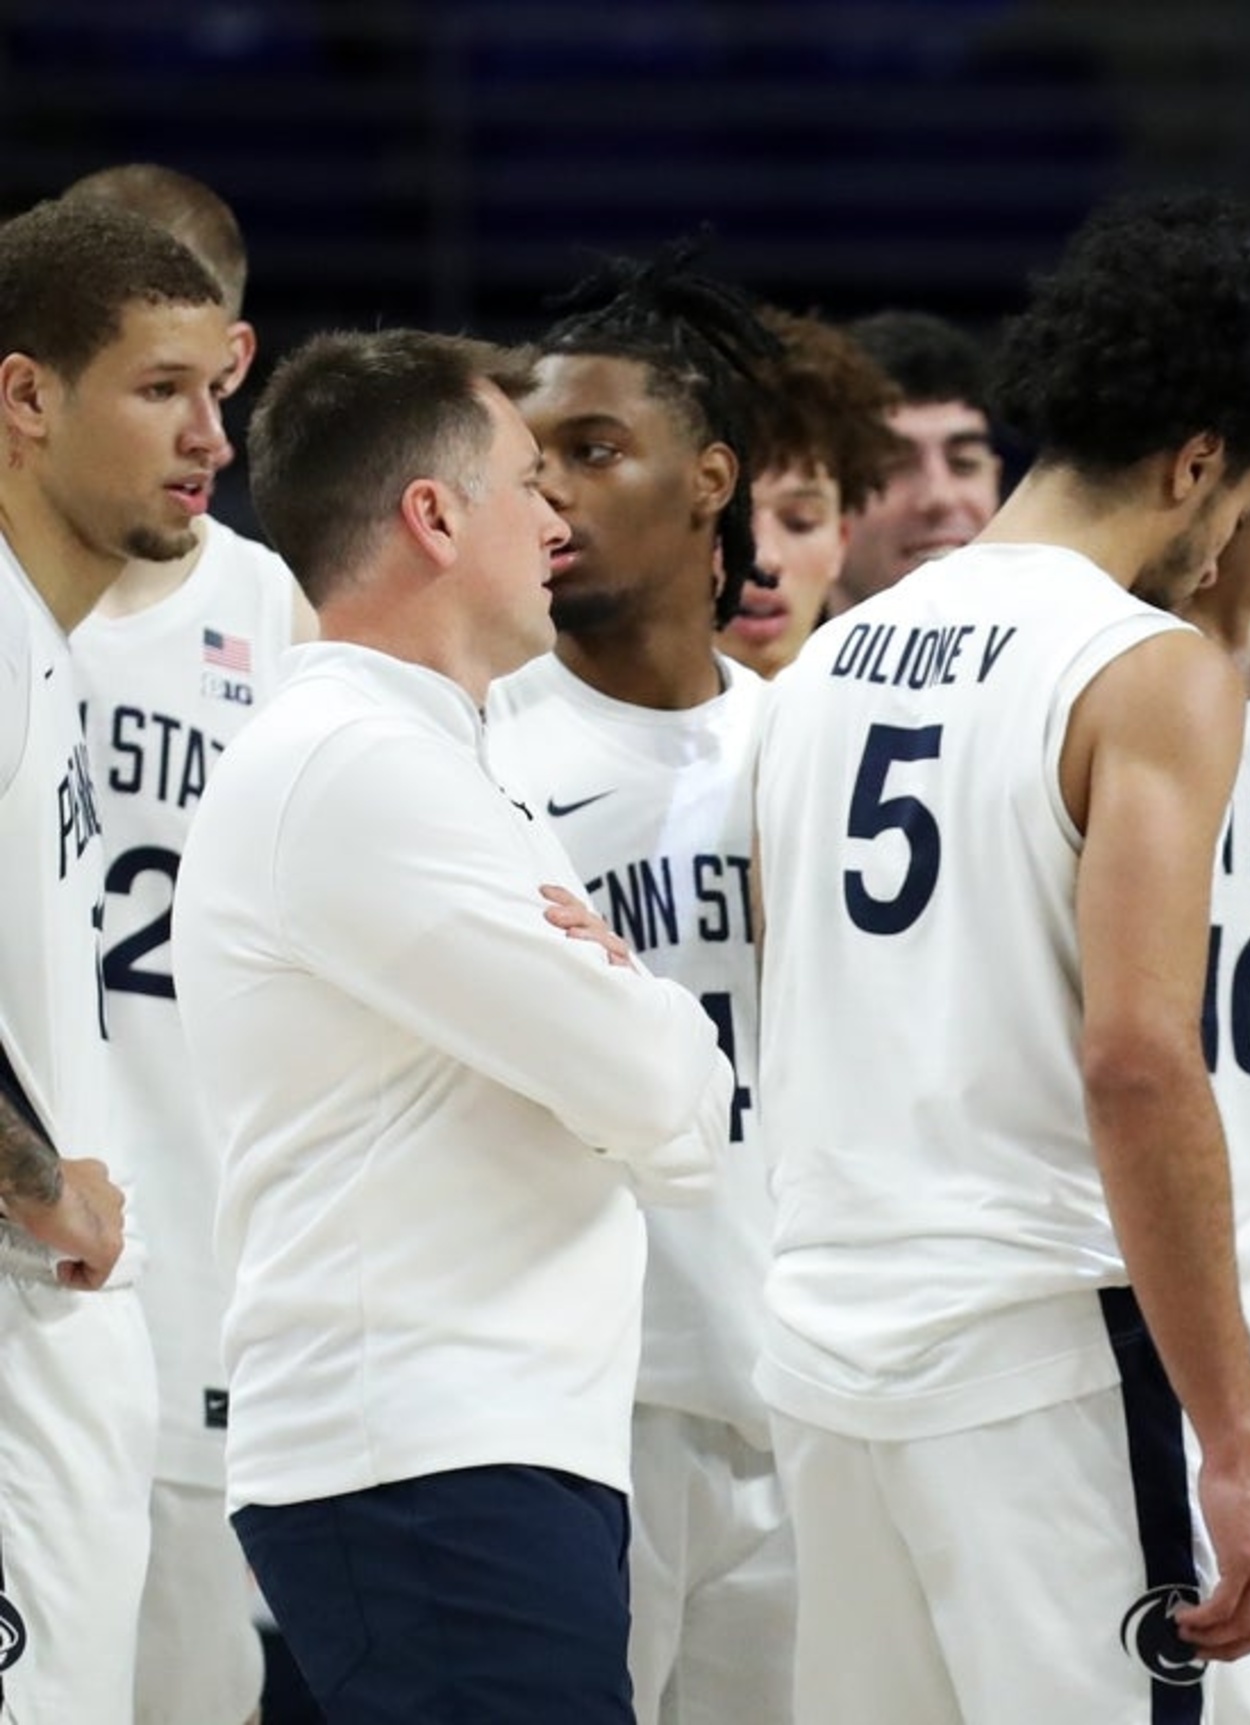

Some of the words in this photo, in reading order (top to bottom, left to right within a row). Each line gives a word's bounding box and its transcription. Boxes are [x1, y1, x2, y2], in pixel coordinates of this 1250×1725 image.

[830, 623, 976, 690] DILIONE
[976, 624, 1018, 683] V
[109, 704, 224, 808] STA
[844, 723, 943, 935] 5
[102, 845, 182, 1000] 2
